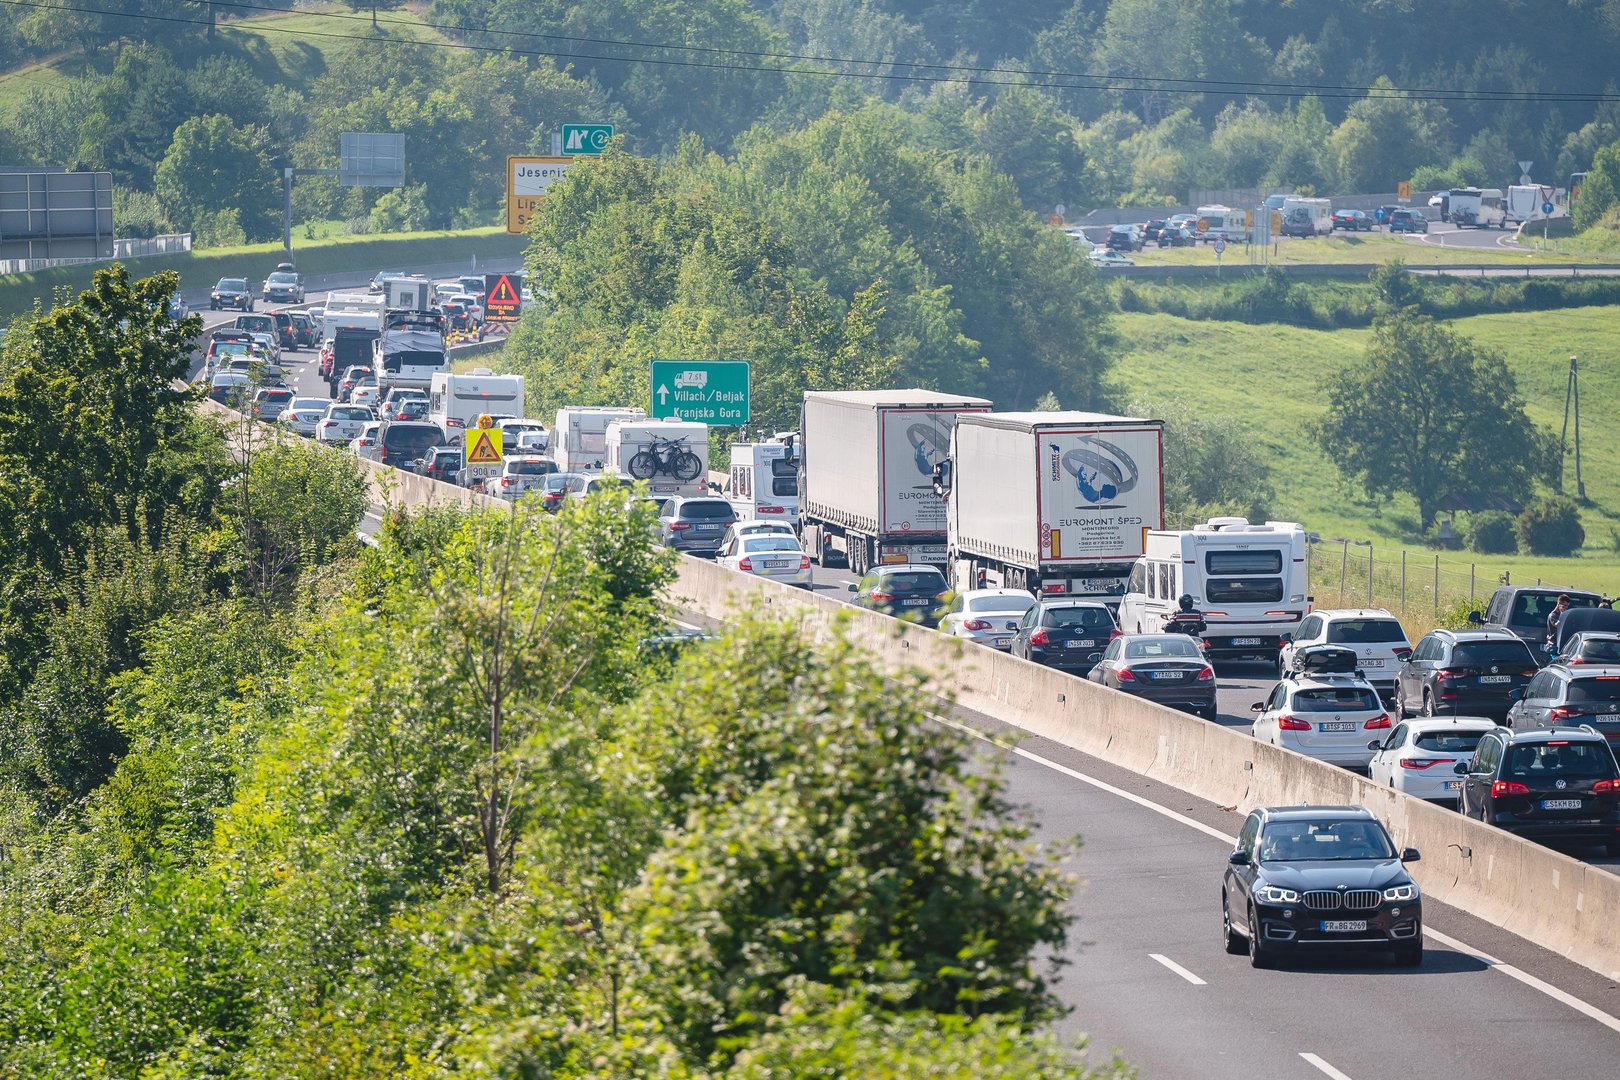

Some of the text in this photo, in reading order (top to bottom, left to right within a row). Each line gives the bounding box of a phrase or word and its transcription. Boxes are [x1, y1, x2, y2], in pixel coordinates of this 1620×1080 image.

[517, 198, 536, 212] Lip
[673, 407, 741, 420] Kranjska Gora
[473, 467, 488, 477] 900
[1059, 517, 1114, 526] EUROMONT
